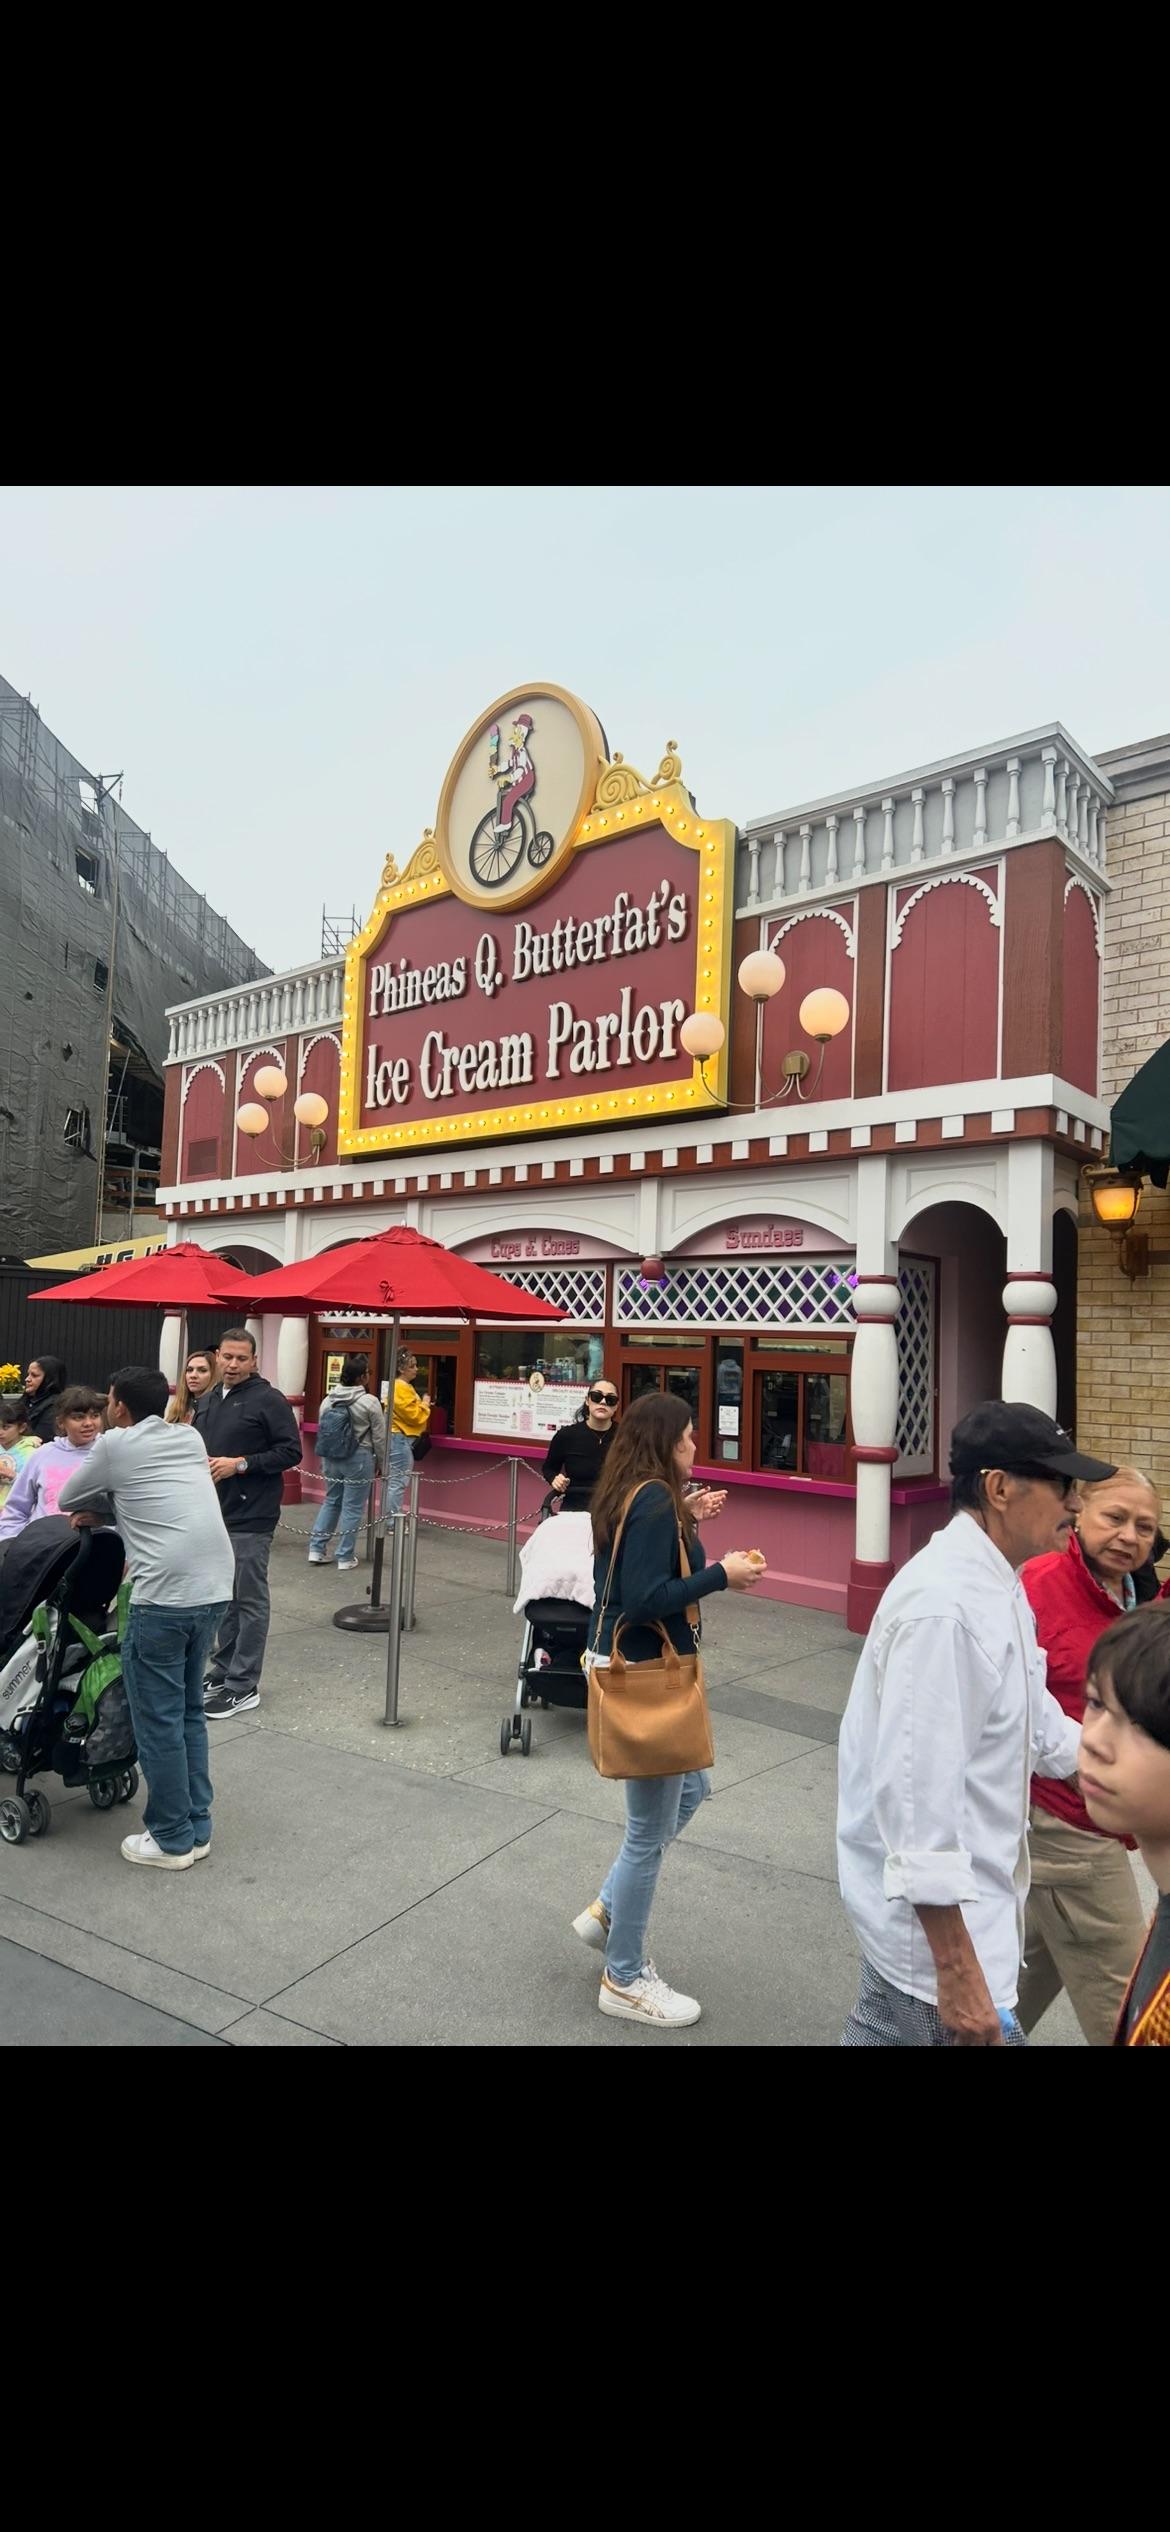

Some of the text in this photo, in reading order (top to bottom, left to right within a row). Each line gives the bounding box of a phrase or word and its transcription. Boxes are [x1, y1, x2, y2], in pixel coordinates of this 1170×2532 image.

[368, 879, 688, 1017] Phineas Q. Butterfat's
[364, 986, 686, 1110] Ice Cream Parlor
[490, 1238, 522, 1260] Cups
[541, 1235, 580, 1256] Cones
[726, 1223, 804, 1250] Sundaes
[2, 1660, 32, 1700] summer
